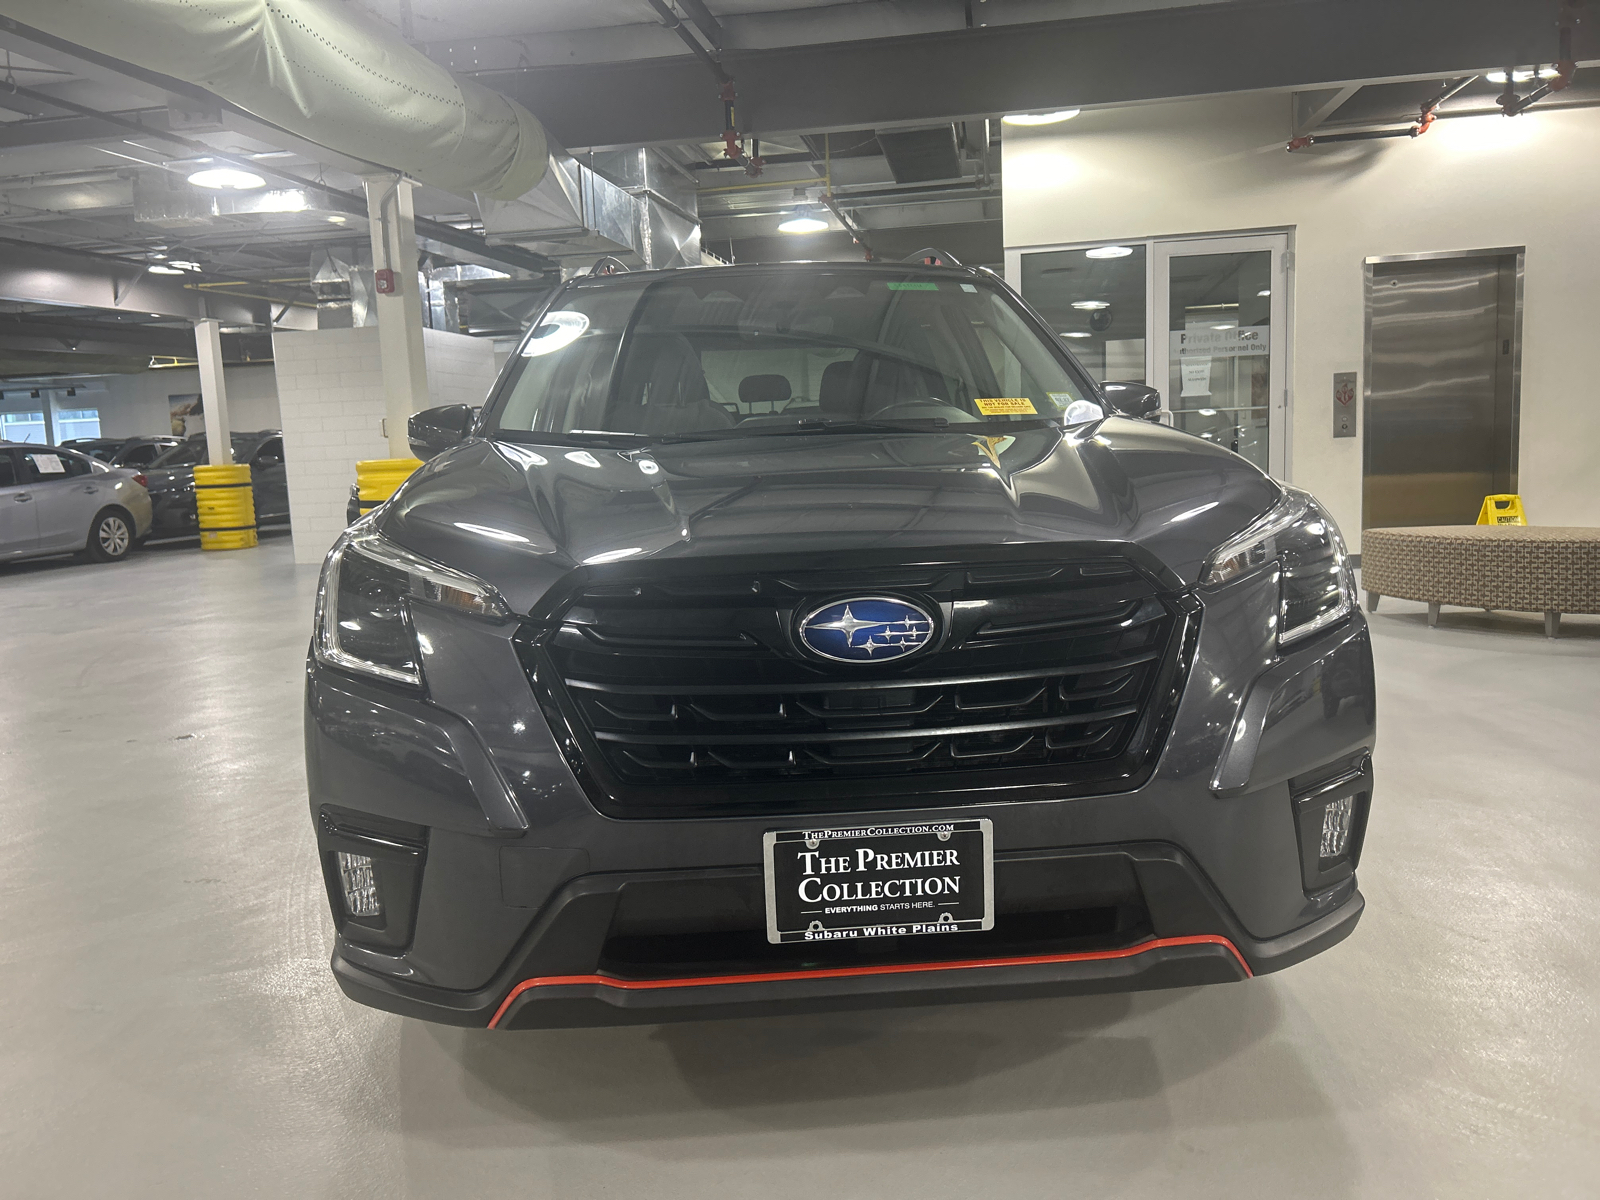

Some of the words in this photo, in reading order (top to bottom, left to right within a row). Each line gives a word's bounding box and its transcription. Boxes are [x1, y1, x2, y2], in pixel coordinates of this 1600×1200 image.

[1181, 332, 1221, 344] Private
[1225, 330, 1259, 342] Office
[1213, 344, 1248, 353] Personnel
[1251, 343, 1267, 351] Only
[797, 851, 851, 875] THE
[856, 848, 960, 872] PREMIER
[798, 876, 961, 903] COLLECTION
[825, 904, 878, 914] EVERYTHING
[880, 902, 910, 911] STARTS
[912, 901, 935, 909] HERE.
[804, 929, 858, 940] Subaru
[863, 926, 907, 937] White
[912, 923, 959, 934] Plains
